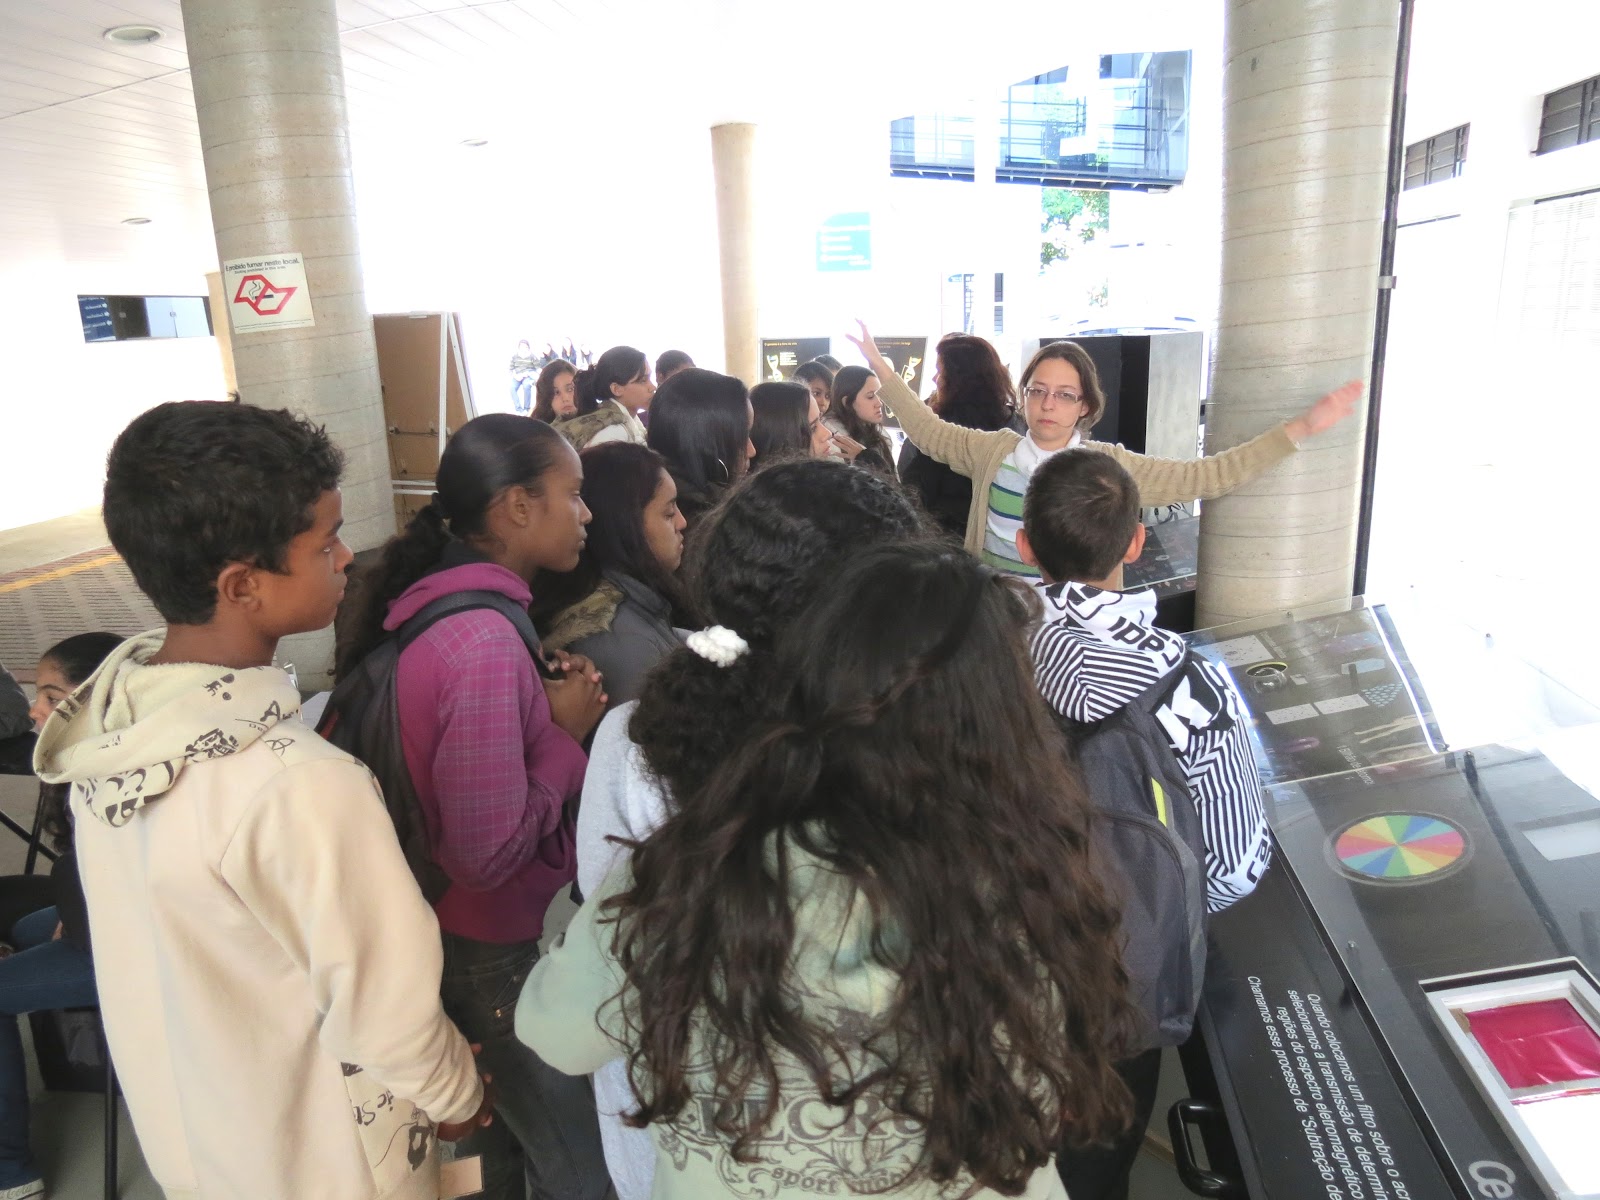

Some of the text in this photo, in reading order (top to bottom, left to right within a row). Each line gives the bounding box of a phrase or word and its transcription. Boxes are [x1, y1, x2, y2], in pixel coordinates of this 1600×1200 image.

[1247, 975, 1274, 1023] Chamamos
[1265, 1025, 1283, 1047] esse
[1287, 989, 1322, 1050] selecionamos
[1271, 1049, 1301, 1096] processo
[1313, 1051, 1326, 1059] a
[1276, 1006, 1365, 1200] regiões do espectro eletromagnético
[1307, 993, 1331, 1028] Quando
[1323, 1030, 1355, 1082] colocamos
[1347, 1084, 1364, 1101] um
[1357, 1103, 1376, 1128] filtro
[1369, 1131, 1394, 1166] sobre
[1386, 1168, 1400, 1178] o
[1318, 1061, 1355, 1125] transmissão
[1293, 1098, 1310, 1113] de
[1346, 1128, 1364, 1143] de
[771, 1166, 838, 1195] sport
[1325, 1184, 1344, 1200] de
[1468, 1160, 1516, 1199] Ce
